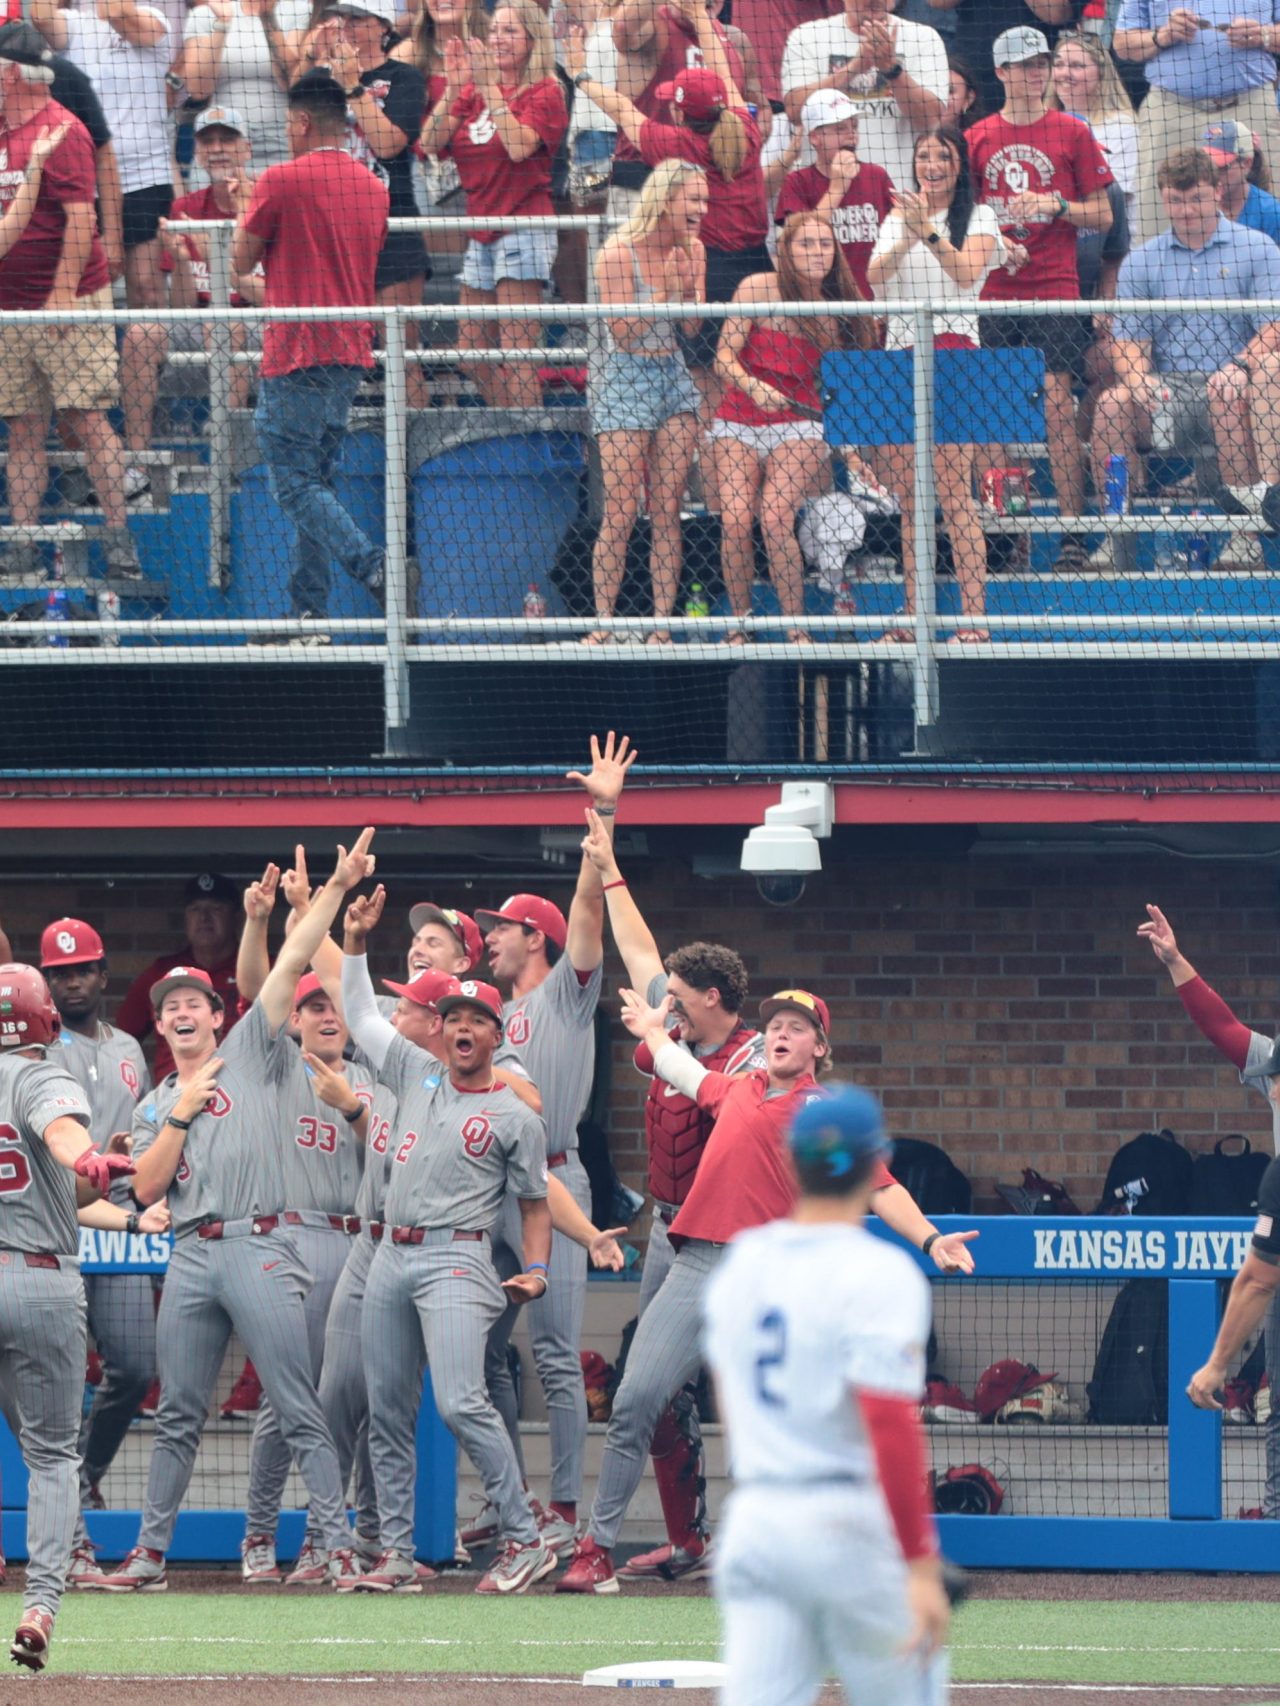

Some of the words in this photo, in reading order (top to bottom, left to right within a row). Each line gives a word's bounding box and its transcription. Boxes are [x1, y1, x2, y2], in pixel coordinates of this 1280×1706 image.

[1004, 161, 1029, 194] OU
[57, 931, 77, 954] OU
[460, 980, 478, 997] OU
[2, 1022, 16, 1034] 16
[507, 1010, 532, 1046] OU
[297, 1115, 338, 1153] 33
[394, 1130, 418, 1164] 2
[461, 1114, 495, 1159] OU
[78, 1225, 171, 1264] AWKS
[1033, 1230, 1166, 1269] KANSAS
[1172, 1231, 1254, 1270] JAYH
[754, 1307, 787, 1411] 2
[631, 1680, 661, 1688] KANSAS
